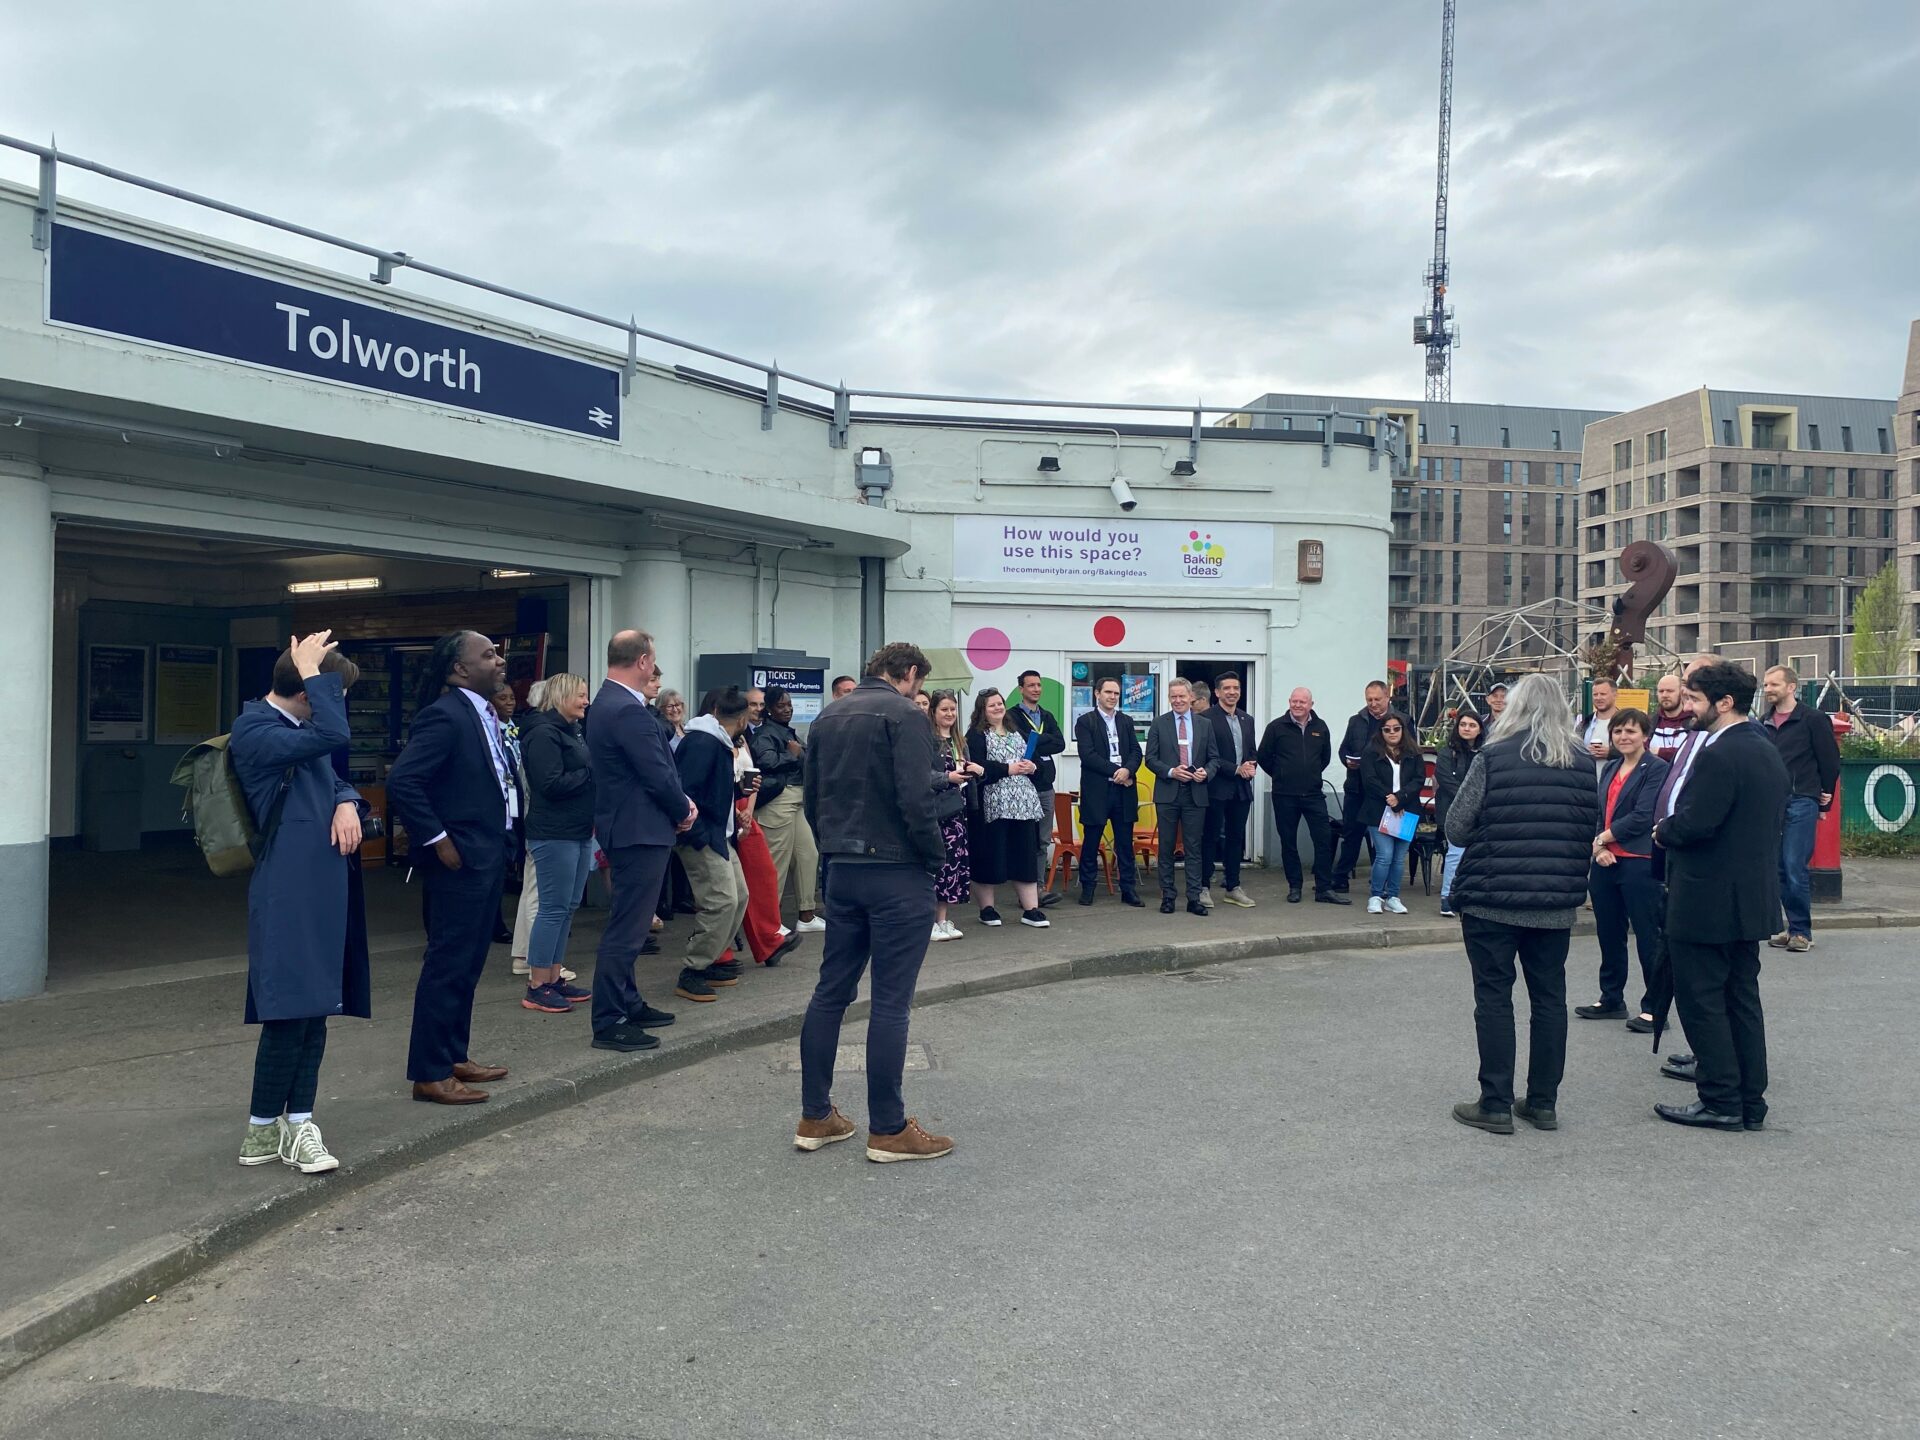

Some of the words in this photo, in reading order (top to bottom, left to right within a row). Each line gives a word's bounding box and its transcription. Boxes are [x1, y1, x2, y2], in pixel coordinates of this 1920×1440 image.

[276, 302, 481, 393] Tolworth
[1004, 526, 1042, 540] How
[1049, 529, 1101, 542] would
[1108, 532, 1139, 547] you
[1003, 546, 1034, 558] use
[1041, 545, 1073, 559] this
[1080, 547, 1142, 563] space?
[1183, 553, 1223, 567] Baking
[1187, 565, 1218, 575] Ideas
[767, 670, 796, 680] TICKETS
[1124, 689, 1152, 704] BEYOND
